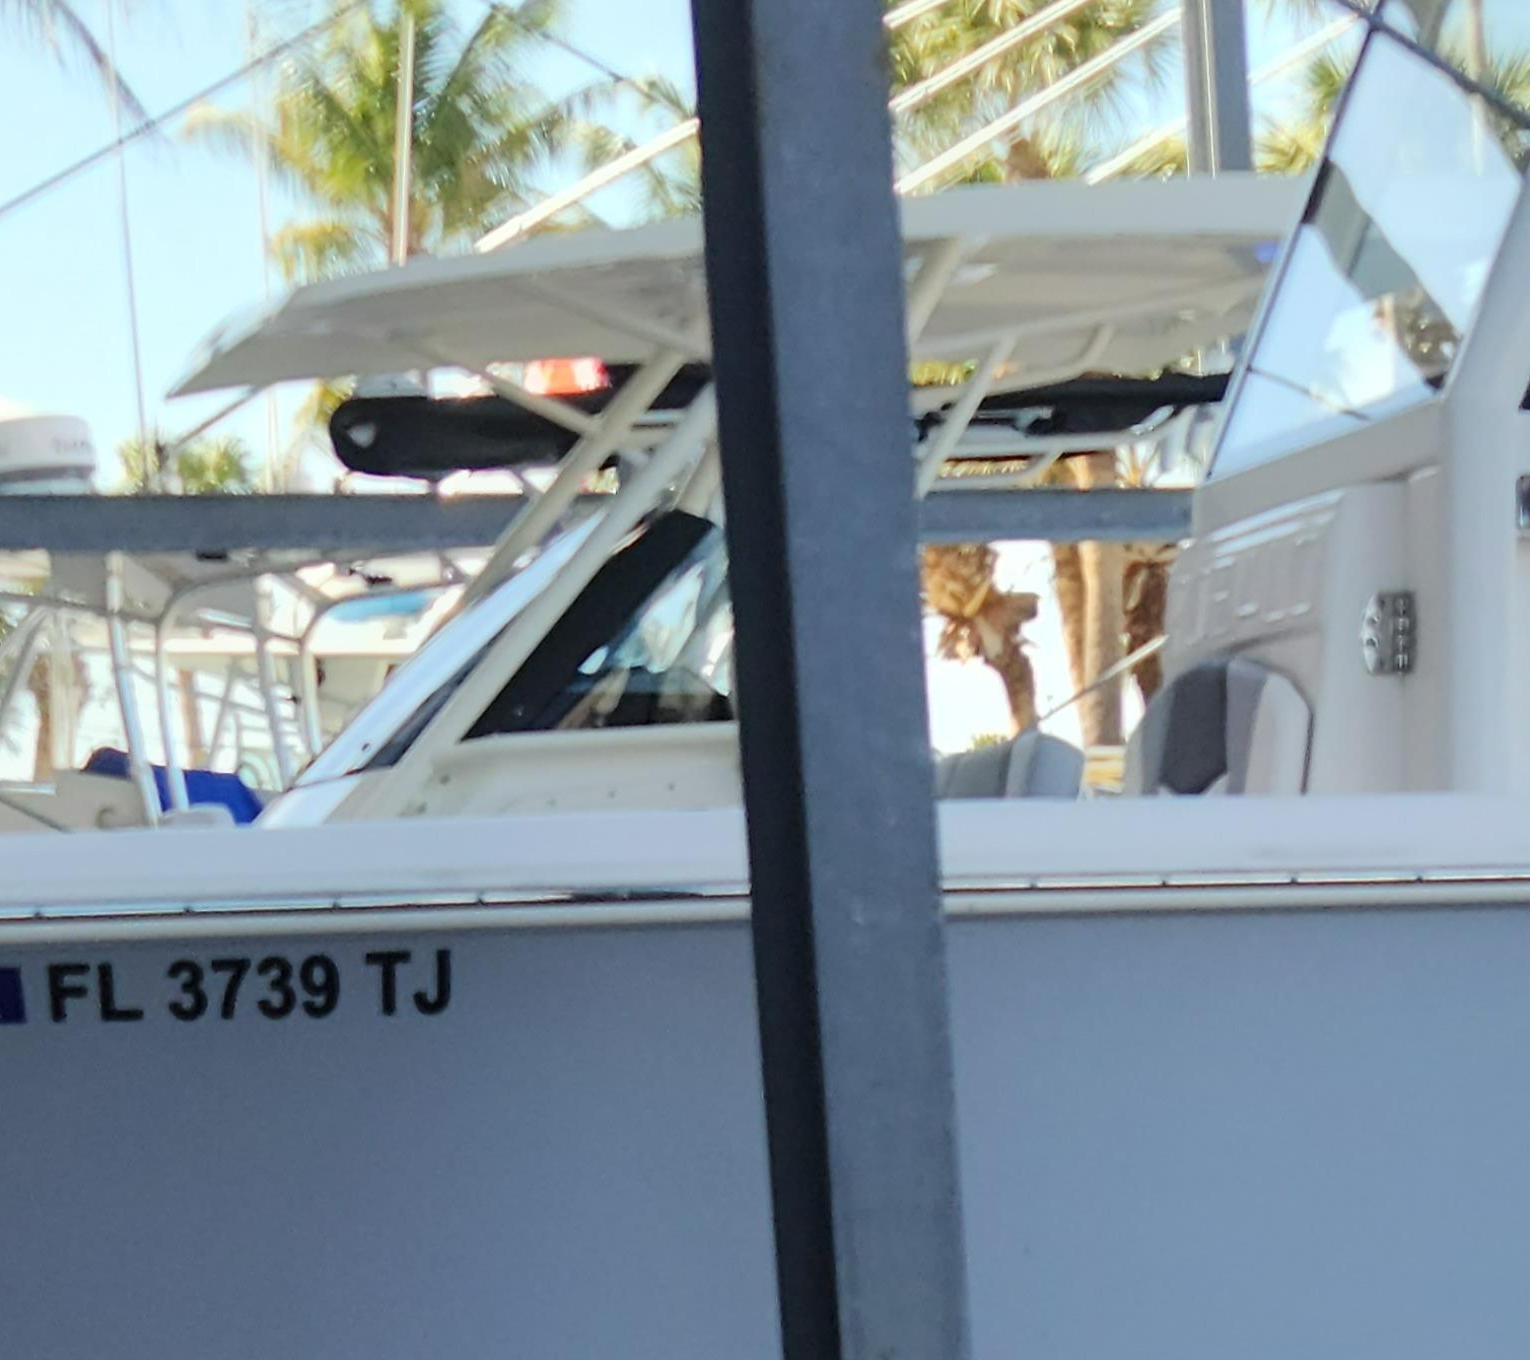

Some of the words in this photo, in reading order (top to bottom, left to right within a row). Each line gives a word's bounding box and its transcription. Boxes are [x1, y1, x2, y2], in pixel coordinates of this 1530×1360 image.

[47, 962, 144, 1022] FL
[167, 955, 341, 1021] 3739
[366, 949, 452, 1016] TJ
